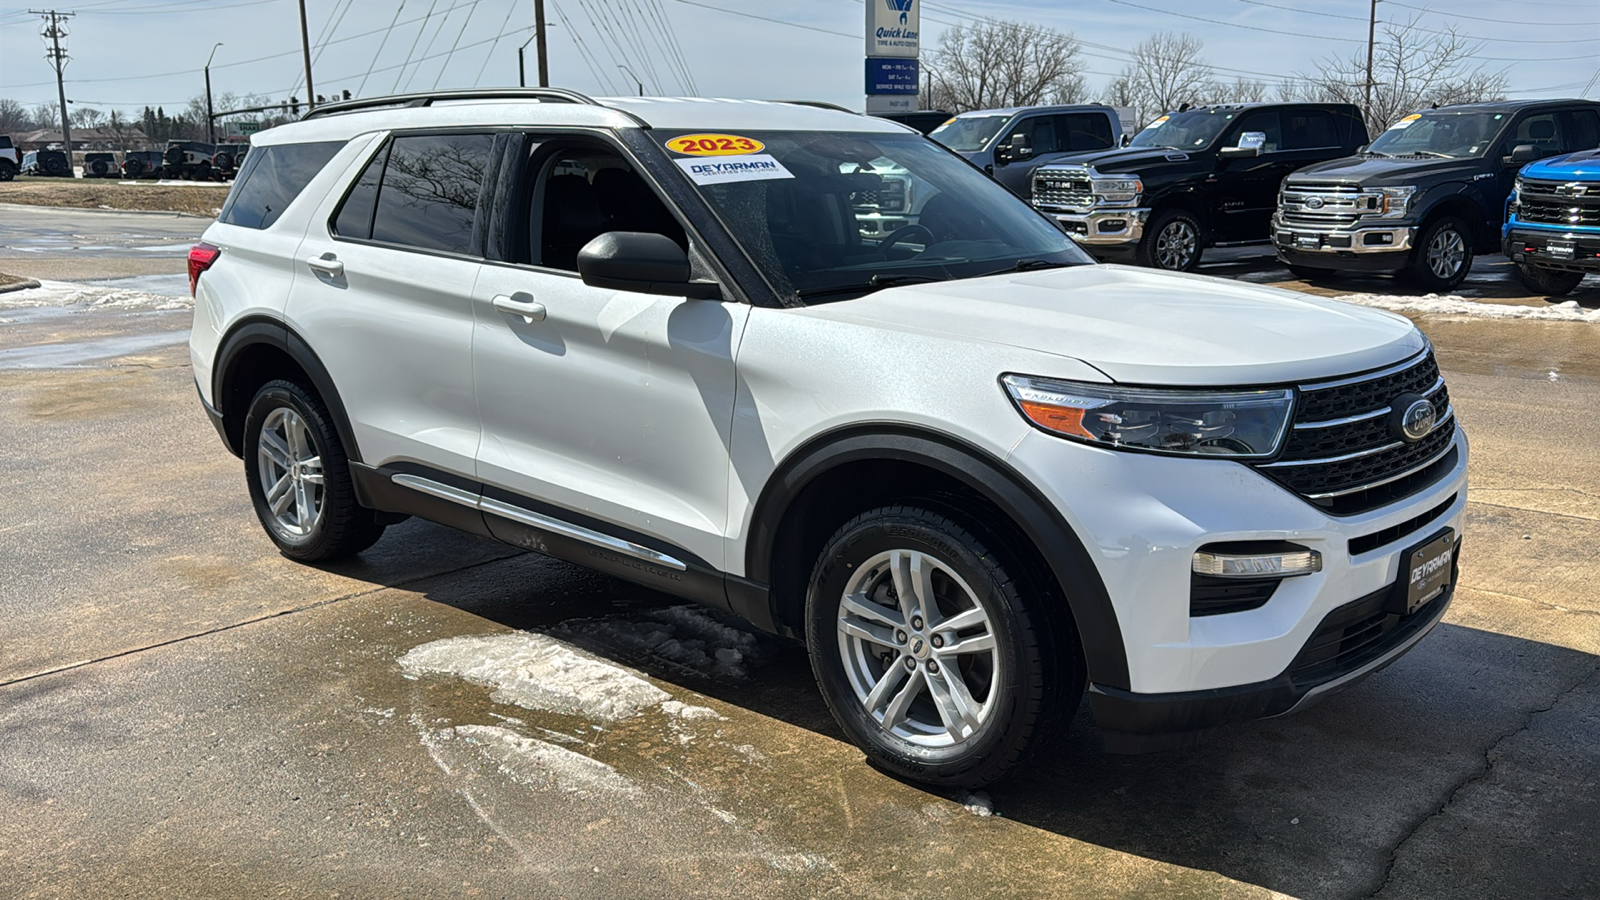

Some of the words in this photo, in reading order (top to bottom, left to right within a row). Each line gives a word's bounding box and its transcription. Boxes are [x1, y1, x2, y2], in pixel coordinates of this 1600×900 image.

[876, 27, 901, 38] Quick
[902, 28, 918, 39] Lane
[679, 138, 757, 152] 2023
[691, 161, 777, 174] DEYARMAN
[702, 169, 739, 177] CERTIFIED
[1046, 181, 1071, 189] RAM
[589, 549, 680, 581] EXPLORER
[1410, 547, 1452, 584] DEYARMAN
